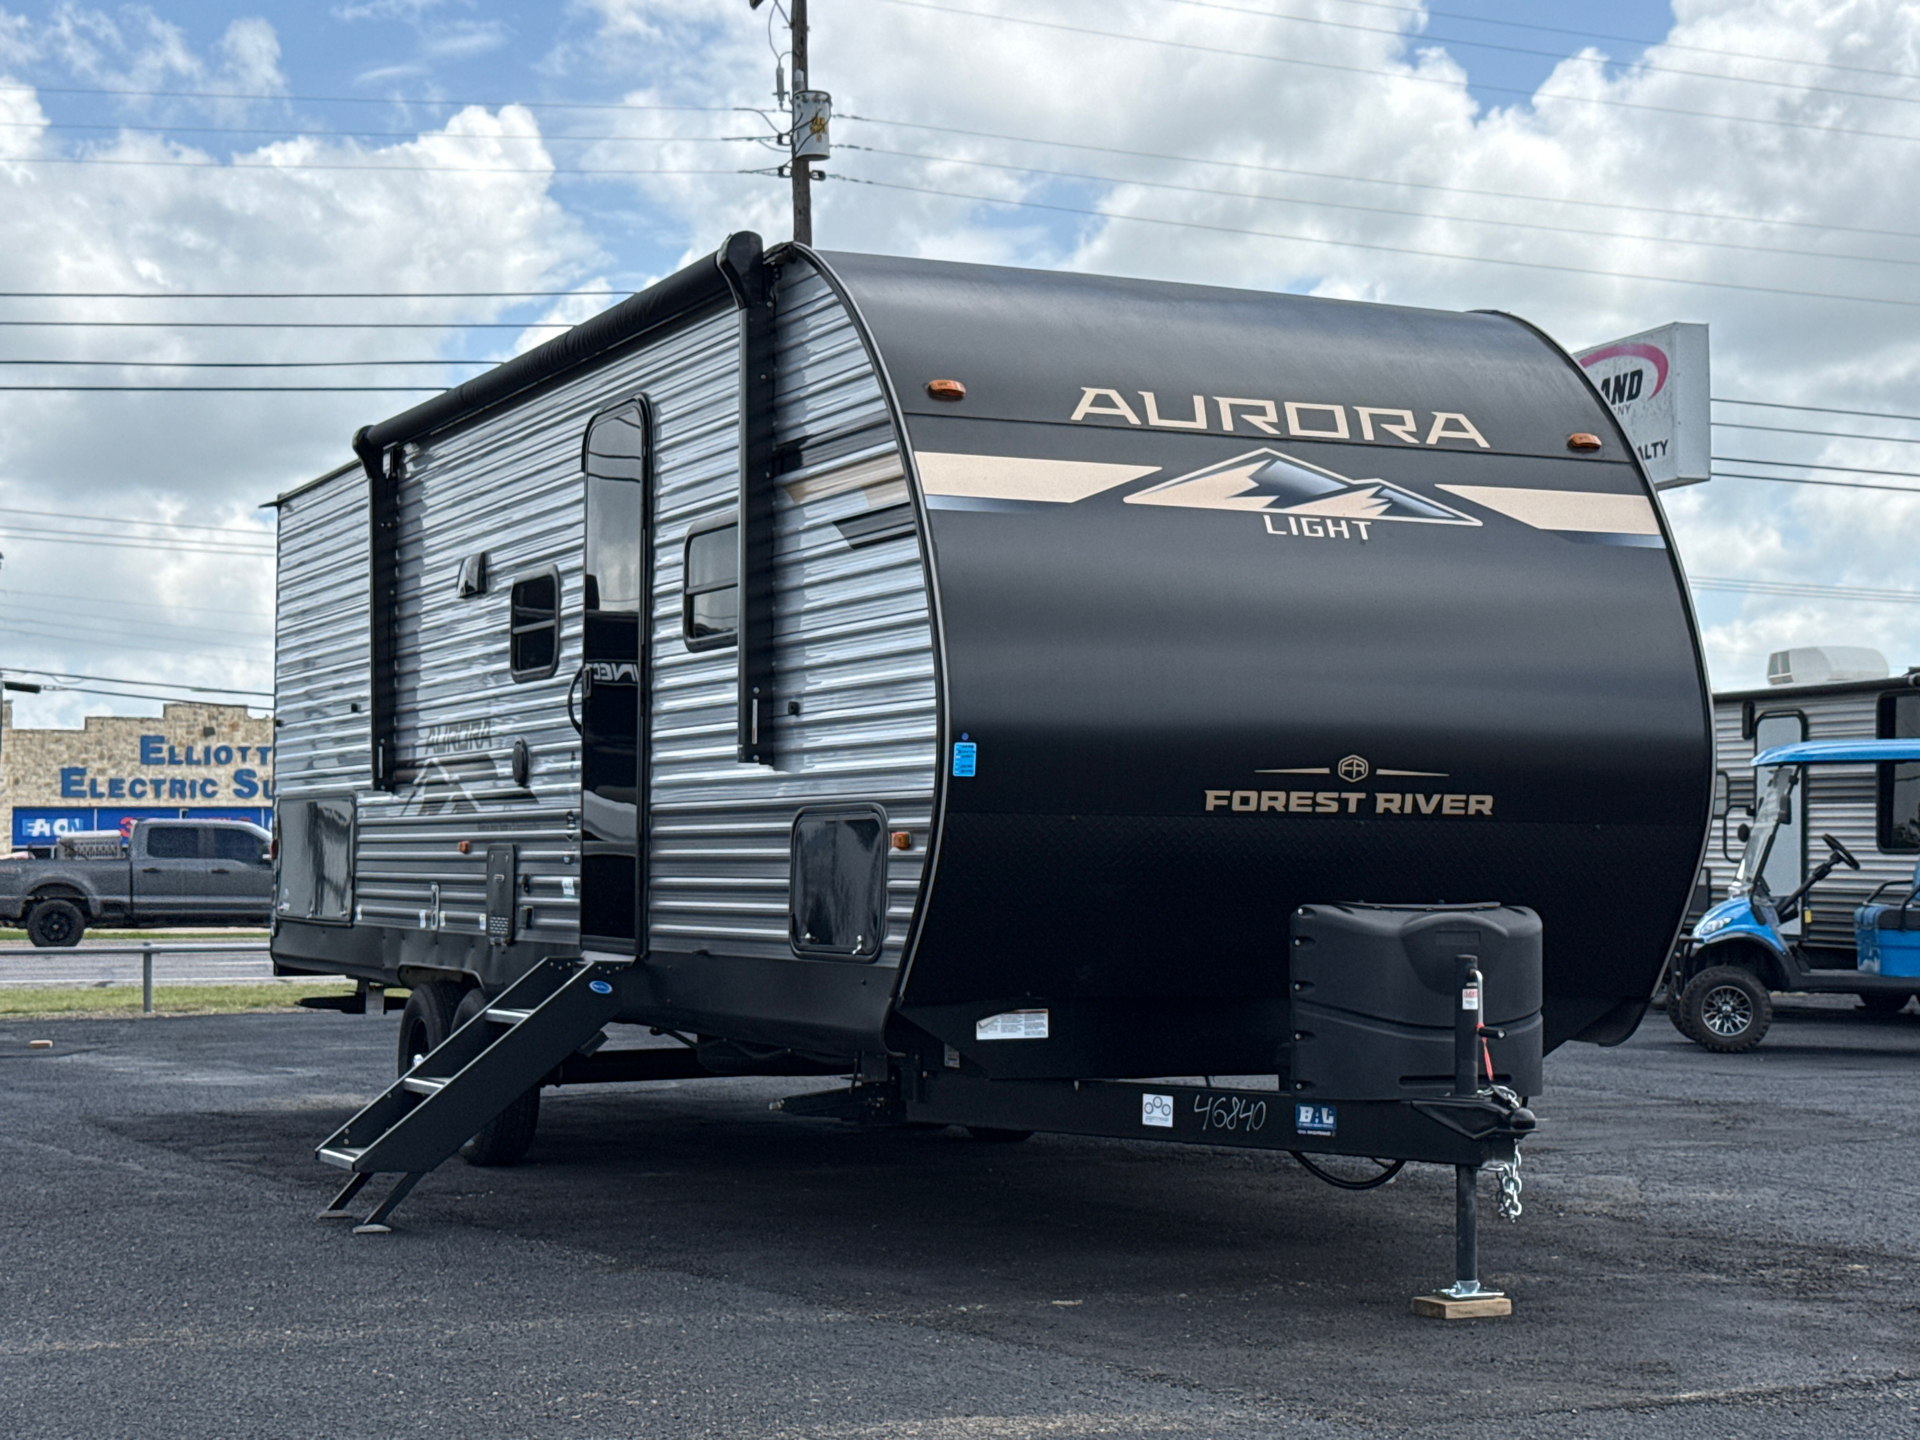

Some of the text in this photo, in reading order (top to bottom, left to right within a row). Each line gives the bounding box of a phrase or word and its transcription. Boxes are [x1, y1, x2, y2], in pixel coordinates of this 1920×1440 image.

[1070, 387, 1491, 448] AURORA
[1263, 514, 1372, 540] LIGHT
[61, 767, 218, 799] ELECTRIC
[1204, 790, 1494, 815] FOREST RIVER
[1193, 1094, 1267, 1132] 46840
